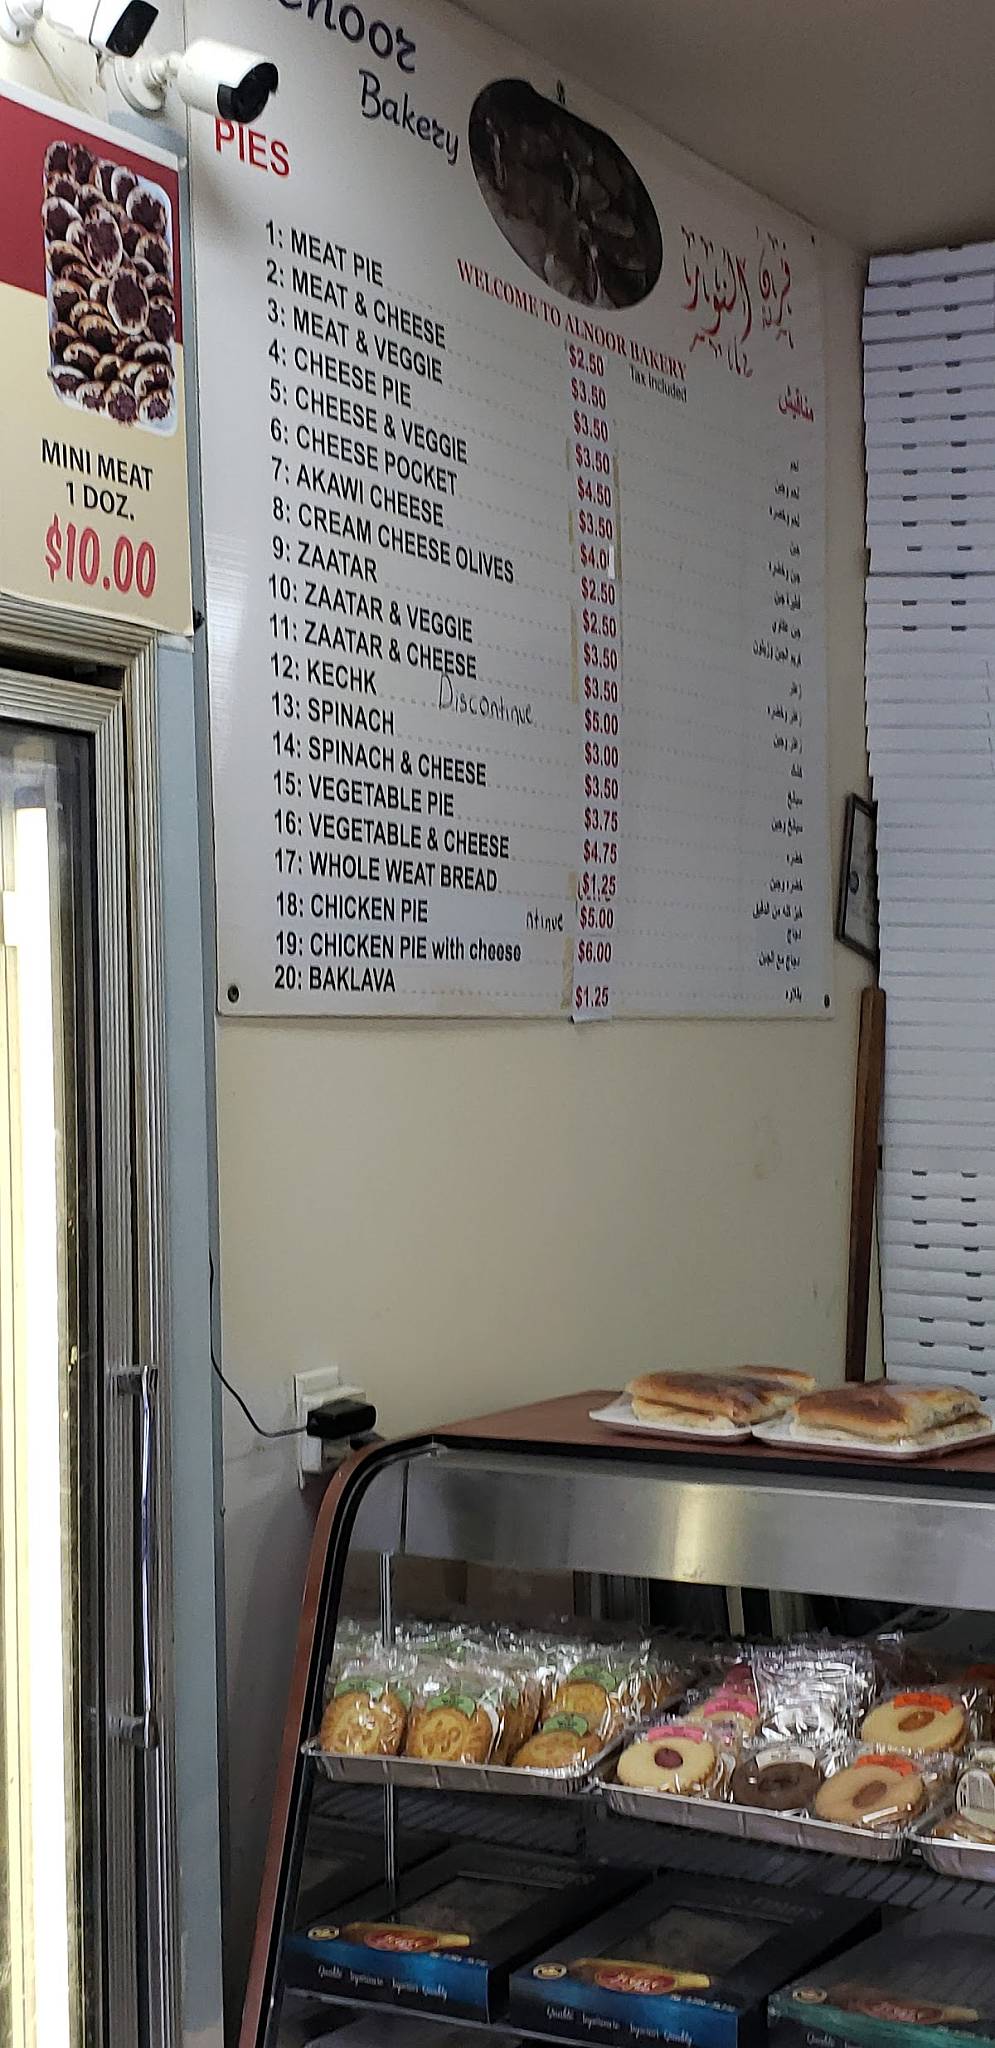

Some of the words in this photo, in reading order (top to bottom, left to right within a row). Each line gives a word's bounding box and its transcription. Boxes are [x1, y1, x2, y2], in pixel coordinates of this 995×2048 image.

[279, 0, 416, 74] noor
[358, 68, 459, 165] Bakery
[214, 118, 290, 178] PIES
[265, 219, 283, 248] 1:
[291, 227, 347, 272] MEAT
[353, 252, 383, 287] PIE
[266, 259, 284, 288] 2:
[292, 267, 348, 310] MEAT
[354, 292, 368, 318] &
[373, 299, 446, 349] CHEESE
[456, 258, 539, 320] WELCOME
[542, 303, 561, 328] TO
[565, 313, 627, 355] ALNOOR
[629, 339, 687, 381] BAKERY
[267, 298, 286, 327] 3:
[293, 306, 349, 347] MEAT
[355, 329, 369, 356] &
[373, 334, 443, 385] VEGGIE
[569, 344, 604, 377] $2.50
[268, 338, 287, 367] 4:
[294, 347, 377, 396] CHEESE
[382, 374, 412, 409] PIE
[630, 364, 646, 387] Tax
[571, 377, 606, 410] $3.50
[269, 377, 287, 405] 5:
[295, 386, 378, 434] CHEESE
[383, 414, 396, 440] &
[401, 418, 468, 465] VEGGIE
[573, 410, 609, 443] $3.50
[41, 437, 91, 477] MINI
[98, 451, 153, 491] MEAT
[270, 417, 289, 445] 6:
[296, 425, 378, 472] CHEESE
[384, 450, 458, 496] POCKET
[575, 443, 610, 475] $3.50
[65, 482, 76, 506] 1
[82, 484, 135, 521] DOZ.
[271, 456, 290, 485] 7:
[296, 463, 364, 505] AKAWI
[370, 484, 444, 528] CHEESE
[577, 476, 611, 508] $4.50
[272, 496, 291, 524] 8:
[298, 503, 372, 545] CREAM
[377, 524, 451, 567] CHEESE
[455, 546, 514, 584] OLIVES
[579, 509, 613, 540] $3.50
[45, 512, 157, 600] $10.00
[272, 535, 291, 563] 9:
[297, 540, 378, 583] ZAATAR
[268, 573, 298, 603] 10:
[304, 579, 383, 623] ZAATAR
[389, 600, 401, 627] &
[406, 603, 473, 643] VEGGIE
[581, 576, 615, 605] $2.50
[583, 608, 616, 638] $2.50
[269, 613, 298, 643] 11:
[304, 619, 383, 660] ZAATAR
[388, 638, 401, 664] &
[406, 642, 477, 680] CHEESE
[583, 641, 618, 672] $3.50
[270, 652, 299, 681] 12:
[307, 657, 377, 696] KECHK
[584, 674, 618, 704] $3.50
[271, 691, 301, 720] 13:
[308, 699, 395, 736] SPINACH
[585, 708, 619, 736] $5.00
[272, 730, 301, 758] 14:
[308, 735, 395, 773] SPINACH
[400, 750, 412, 775] &
[418, 753, 487, 787] CHEESE
[585, 741, 619, 768] $3.00
[273, 769, 302, 798] 15:
[308, 773, 422, 814] VEGETABLE
[427, 791, 455, 818] PIE
[585, 774, 619, 800] $3.50
[274, 808, 302, 837] 16:
[309, 812, 422, 850] VEGETABLE
[427, 827, 439, 852] &
[444, 830, 510, 860] CHEESE
[584, 807, 618, 832] $3.75
[274, 847, 302, 875] 17:
[308, 851, 380, 882] WHOLE
[385, 859, 436, 887] WEAT
[440, 867, 498, 892] BREAD
[583, 838, 617, 864] $4.75
[582, 871, 616, 896] $1.25
[275, 891, 304, 917] 18:
[310, 893, 395, 923] CHICKEN
[400, 899, 428, 923] PIE
[580, 905, 614, 930] $5.00
[275, 930, 303, 957] 19:
[309, 932, 394, 960] CHICKEN
[400, 936, 427, 960] PIE
[431, 937, 464, 960] with
[469, 938, 521, 962] cheese
[578, 939, 612, 964] $6.00
[274, 964, 302, 990] 20:
[308, 965, 396, 993] BAKLAVA
[576, 985, 609, 1009] $1.25
